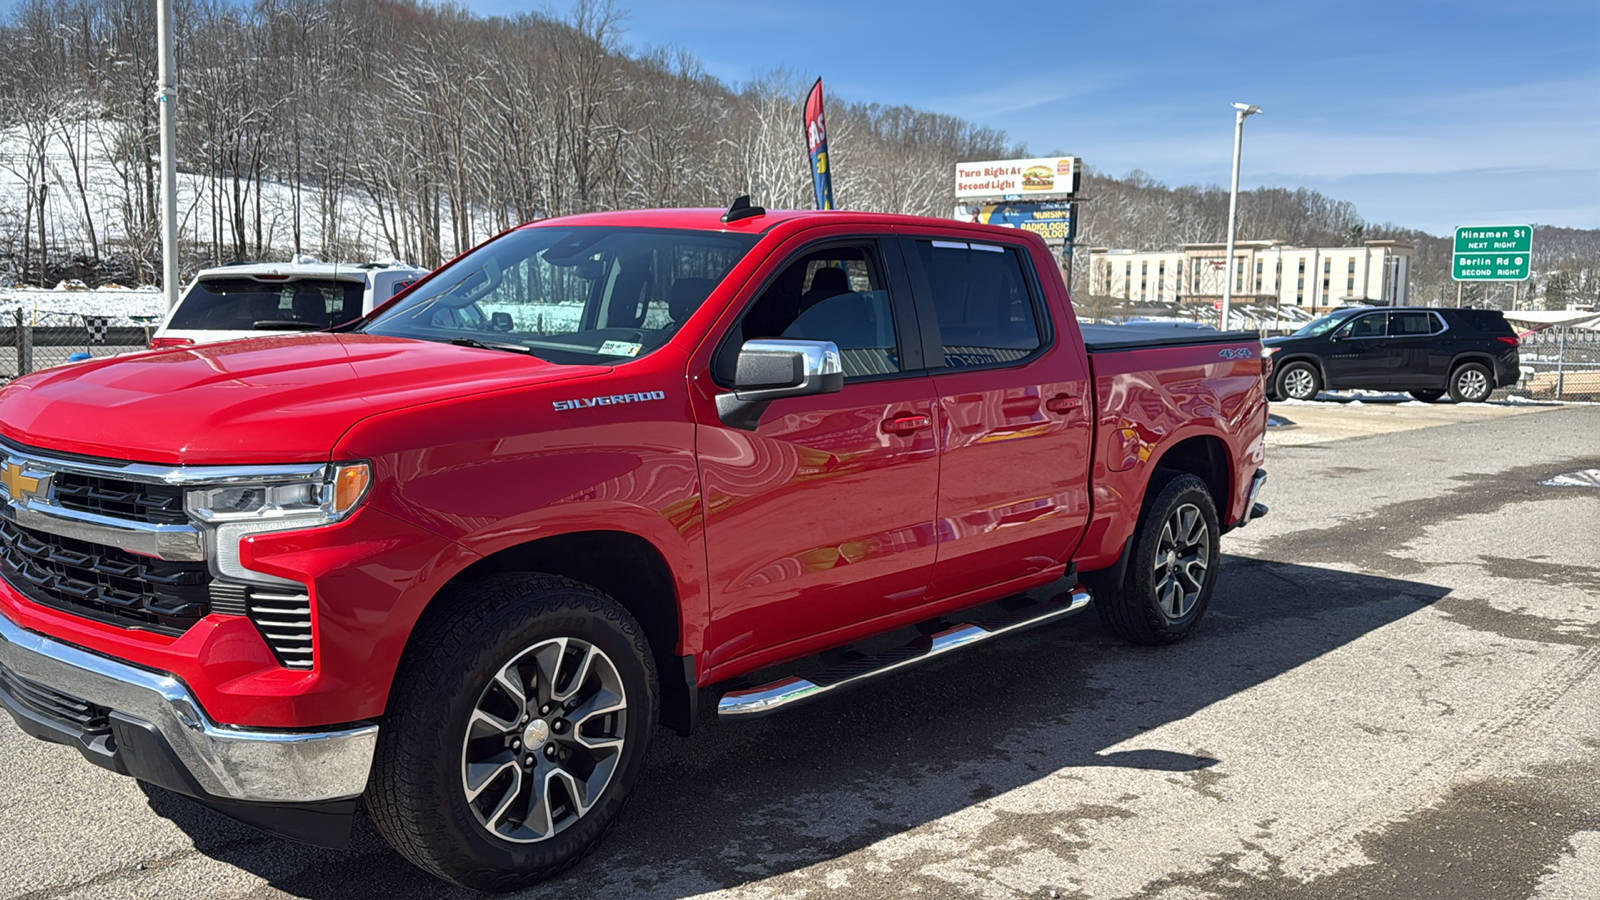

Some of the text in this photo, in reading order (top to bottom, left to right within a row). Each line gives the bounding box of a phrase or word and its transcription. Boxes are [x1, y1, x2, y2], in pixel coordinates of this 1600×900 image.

[958, 167, 1021, 178] Turn Right At
[958, 180, 1015, 191] Second Light
[1020, 221, 1069, 232] RADIOLOGIC
[1461, 229, 1526, 239] Hinzman St
[1493, 241, 1517, 249] RIGHT
[1459, 257, 1491, 266] Berlin
[1496, 257, 1509, 266] Rd
[1497, 268, 1520, 276] RIGHT
[552, 390, 665, 412] SILVERADO
